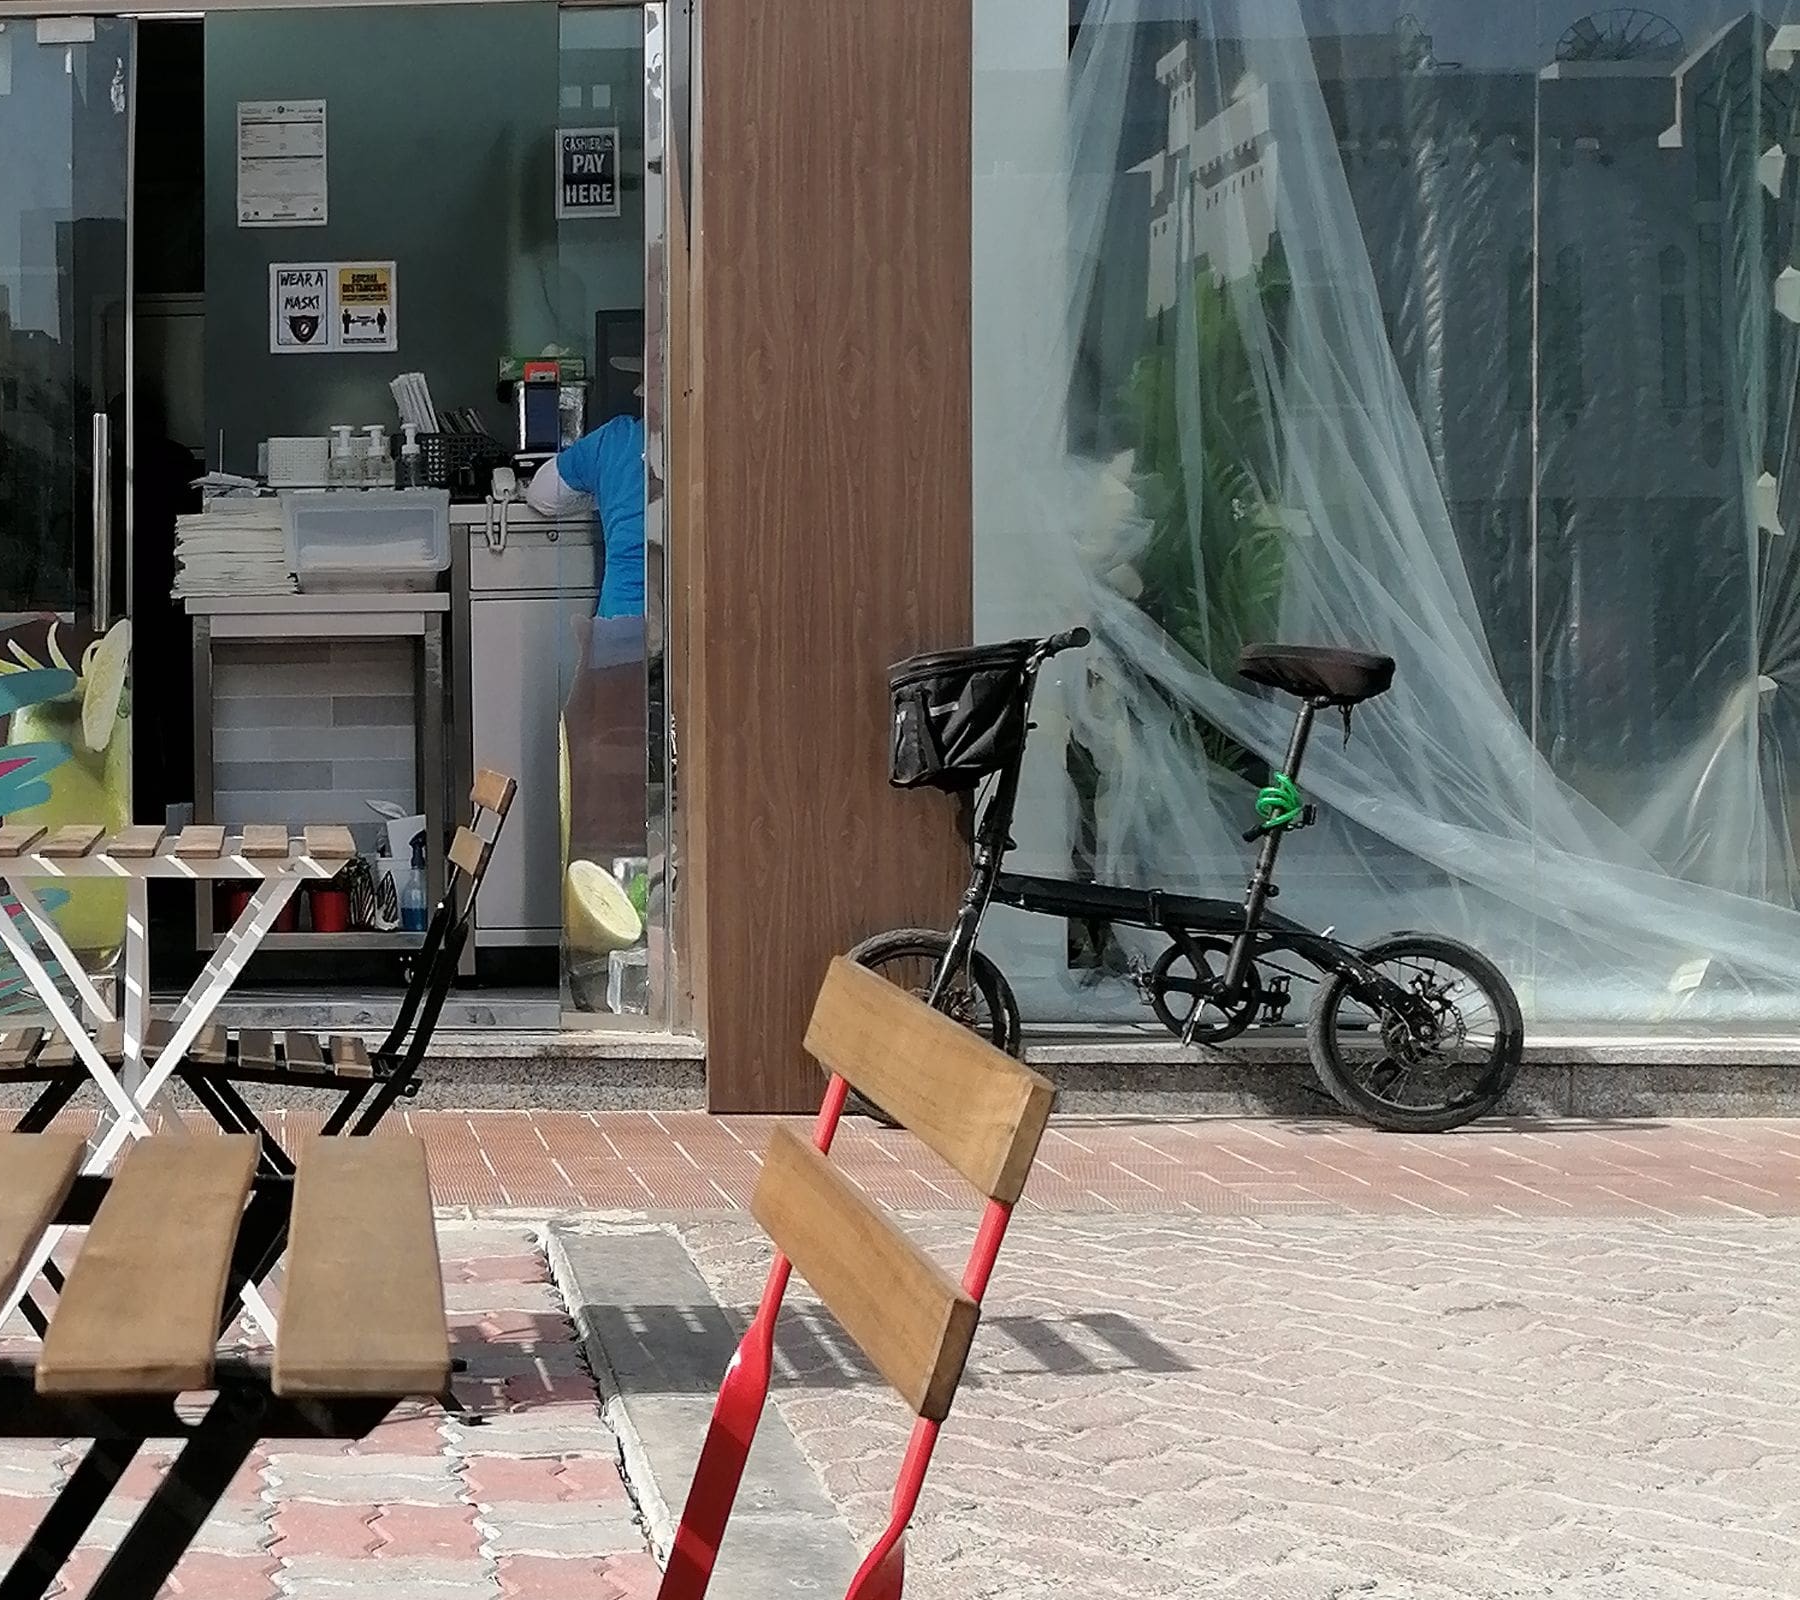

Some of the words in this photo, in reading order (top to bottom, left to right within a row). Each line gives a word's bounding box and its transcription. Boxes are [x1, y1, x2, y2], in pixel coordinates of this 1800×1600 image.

[572, 153, 605, 174] PAY
[565, 183, 612, 204] HERE
[280, 272, 312, 288] WEAR
[314, 272, 324, 288] A
[284, 295, 320, 310] MASK!
